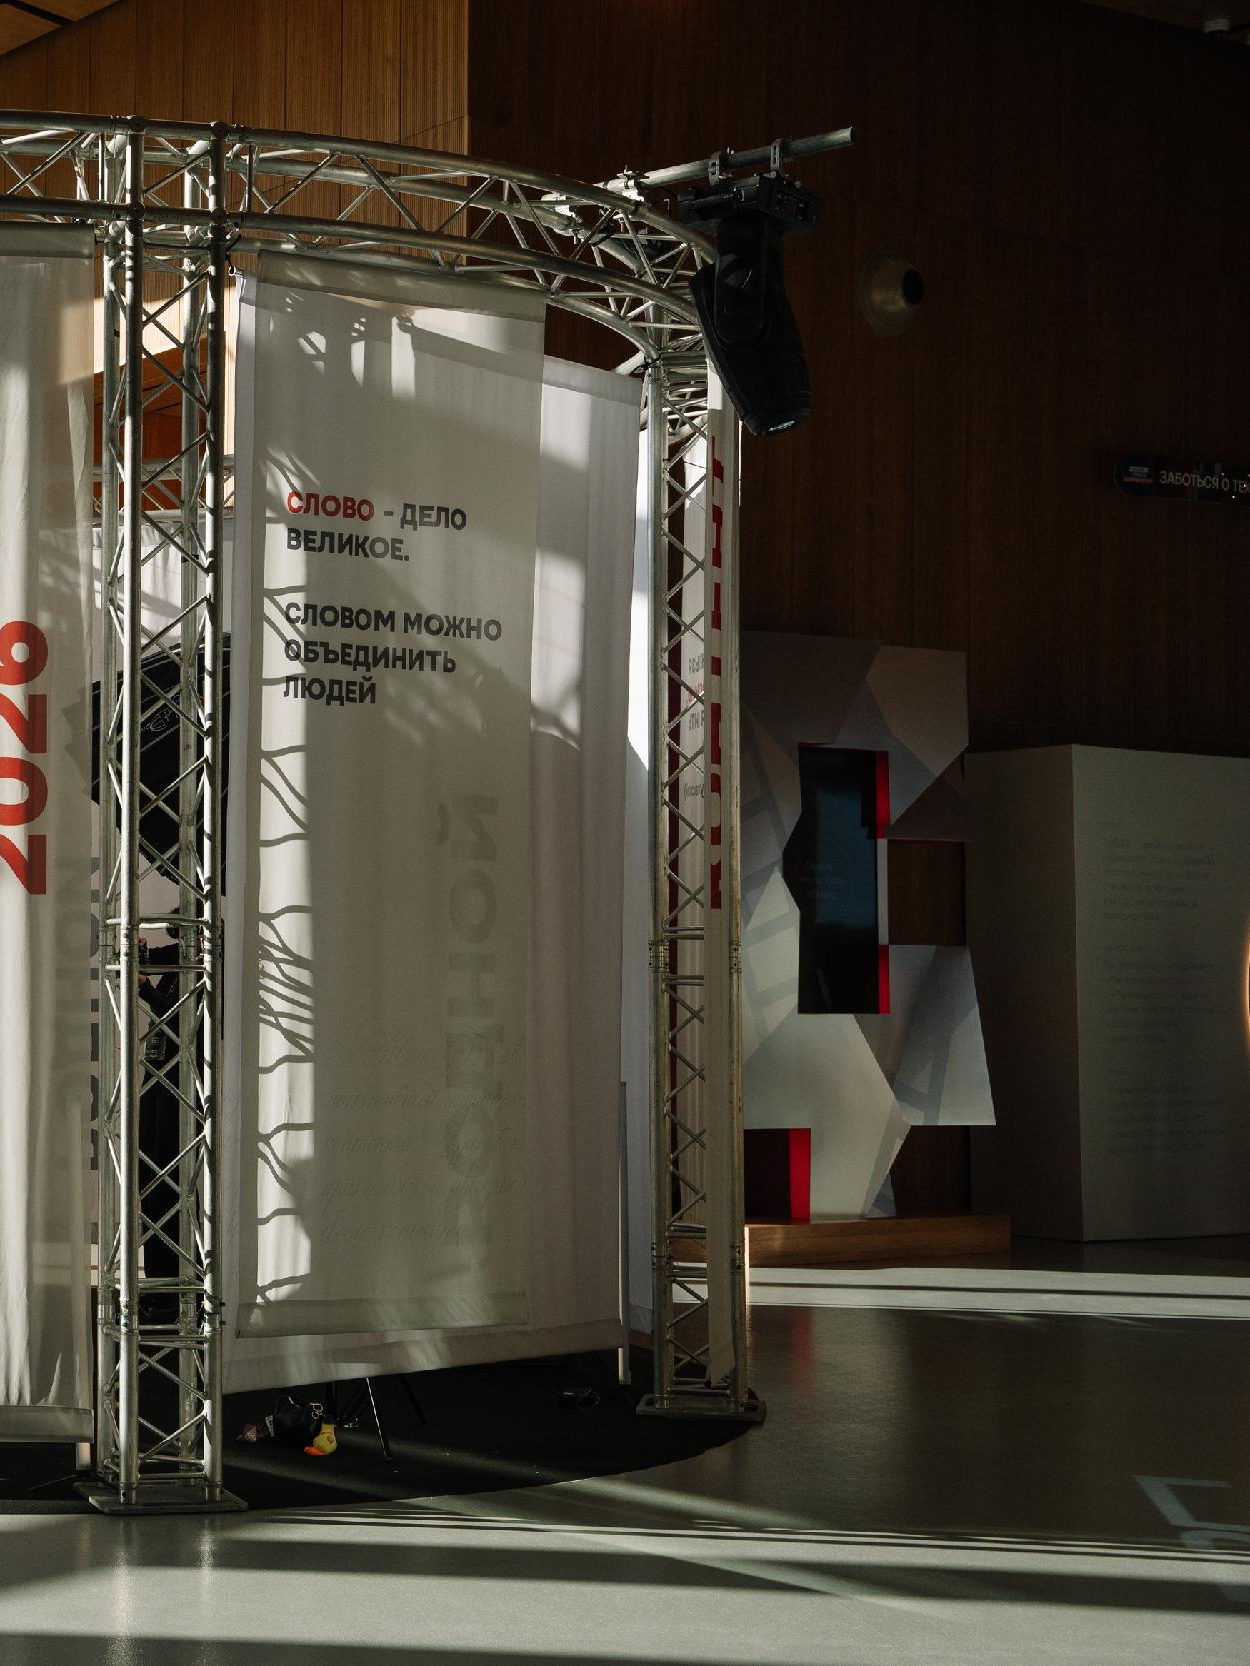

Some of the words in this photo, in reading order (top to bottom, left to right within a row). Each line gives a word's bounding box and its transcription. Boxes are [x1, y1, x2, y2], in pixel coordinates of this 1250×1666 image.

[1159, 470, 1219, 489] ЗАБОТЬСЯ
[1221, 477, 1230, 491] О
[286, 490, 375, 522] СЛОВО
[400, 502, 467, 531] ДЕЛО
[286, 527, 410, 561] ВЕЛИКОЕ.
[284, 602, 396, 633] СЛОВОМ
[403, 611, 503, 642] МОЖНО
[284, 639, 457, 673] ОБЪЕДИНИТЬ
[283, 675, 377, 707] ЛЮДЕЙ
